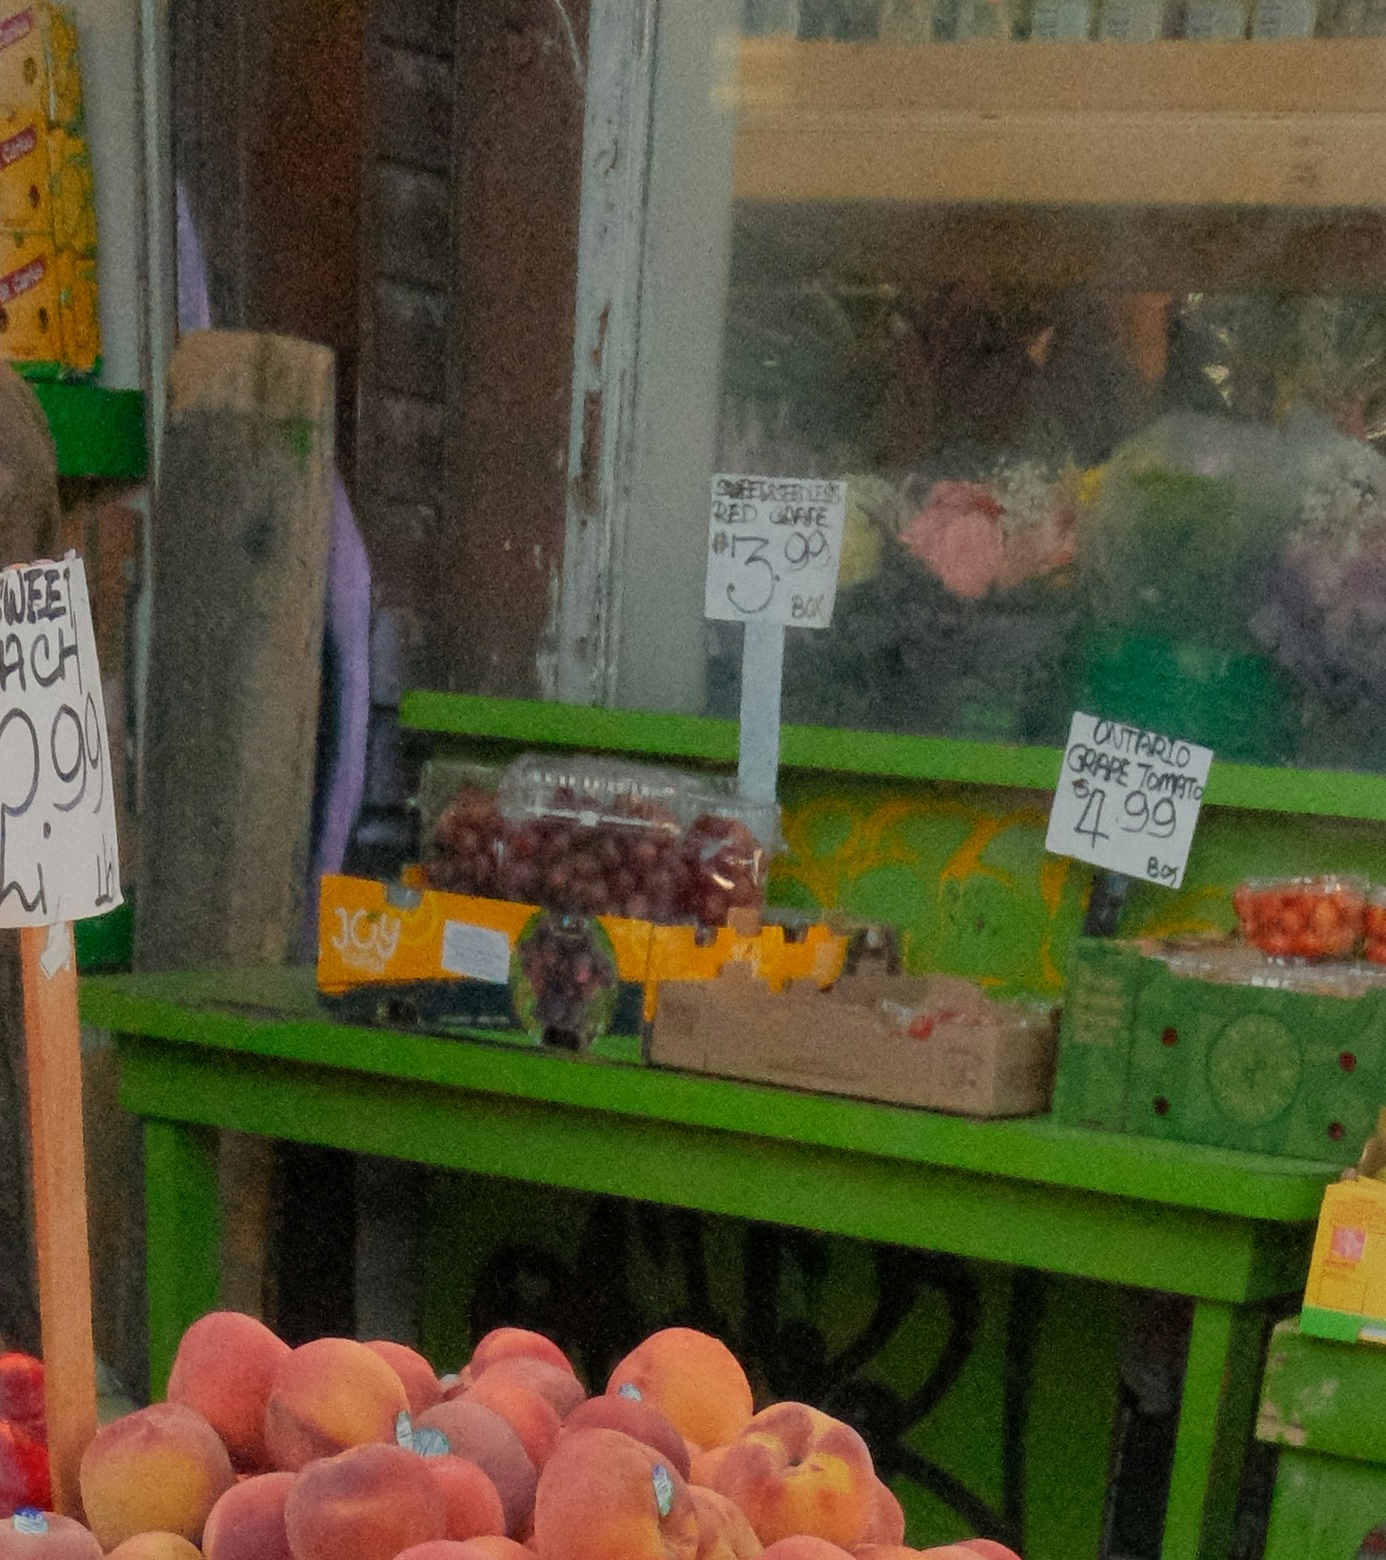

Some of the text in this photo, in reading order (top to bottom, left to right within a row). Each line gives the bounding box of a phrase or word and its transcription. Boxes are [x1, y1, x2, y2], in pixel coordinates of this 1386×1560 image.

[1093, 719, 1191, 769] ONTARIO
[1067, 743, 1204, 801] GRAPE TOMATO
